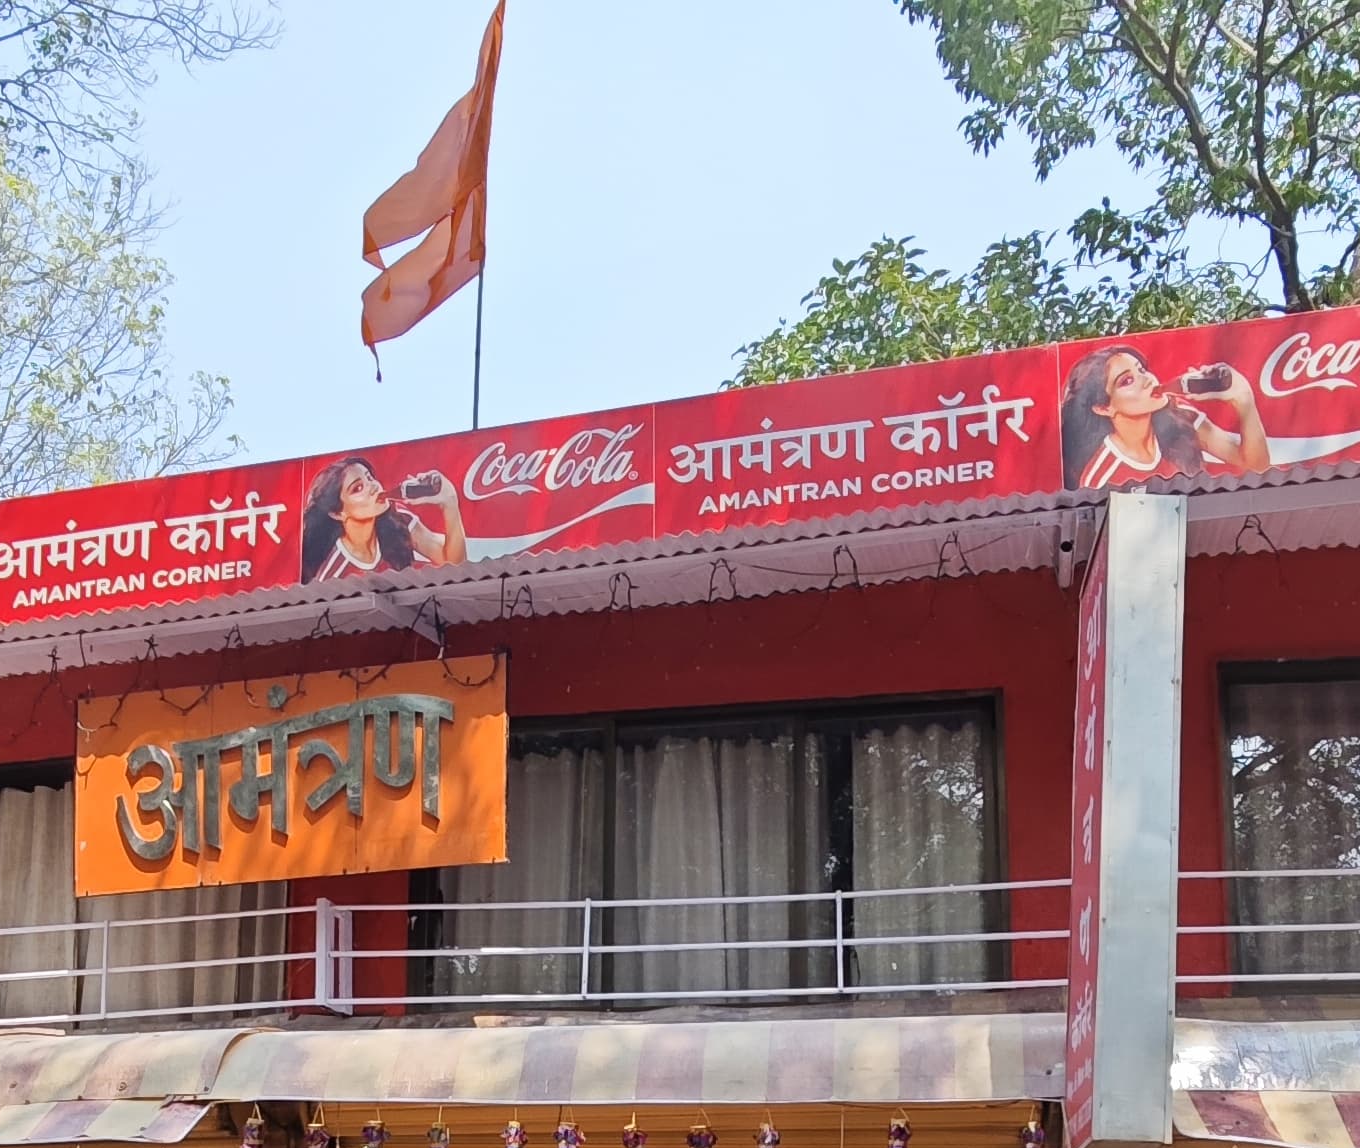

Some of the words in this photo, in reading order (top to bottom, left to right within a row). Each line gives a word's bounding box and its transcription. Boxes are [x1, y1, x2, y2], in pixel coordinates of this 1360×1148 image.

[463, 422, 644, 501] Coca-Cola
[666, 417, 875, 484] आमंत्रण
[881, 385, 1034, 456] कॉर्नर
[166, 490, 288, 556] कॉर्नर
[697, 478, 865, 516] AMANTRAN
[870, 459, 994, 494] CORNER
[12, 573, 145, 609] AMANTRAN
[152, 560, 251, 591] CORNER
[116, 683, 455, 862] आमंत्रण
